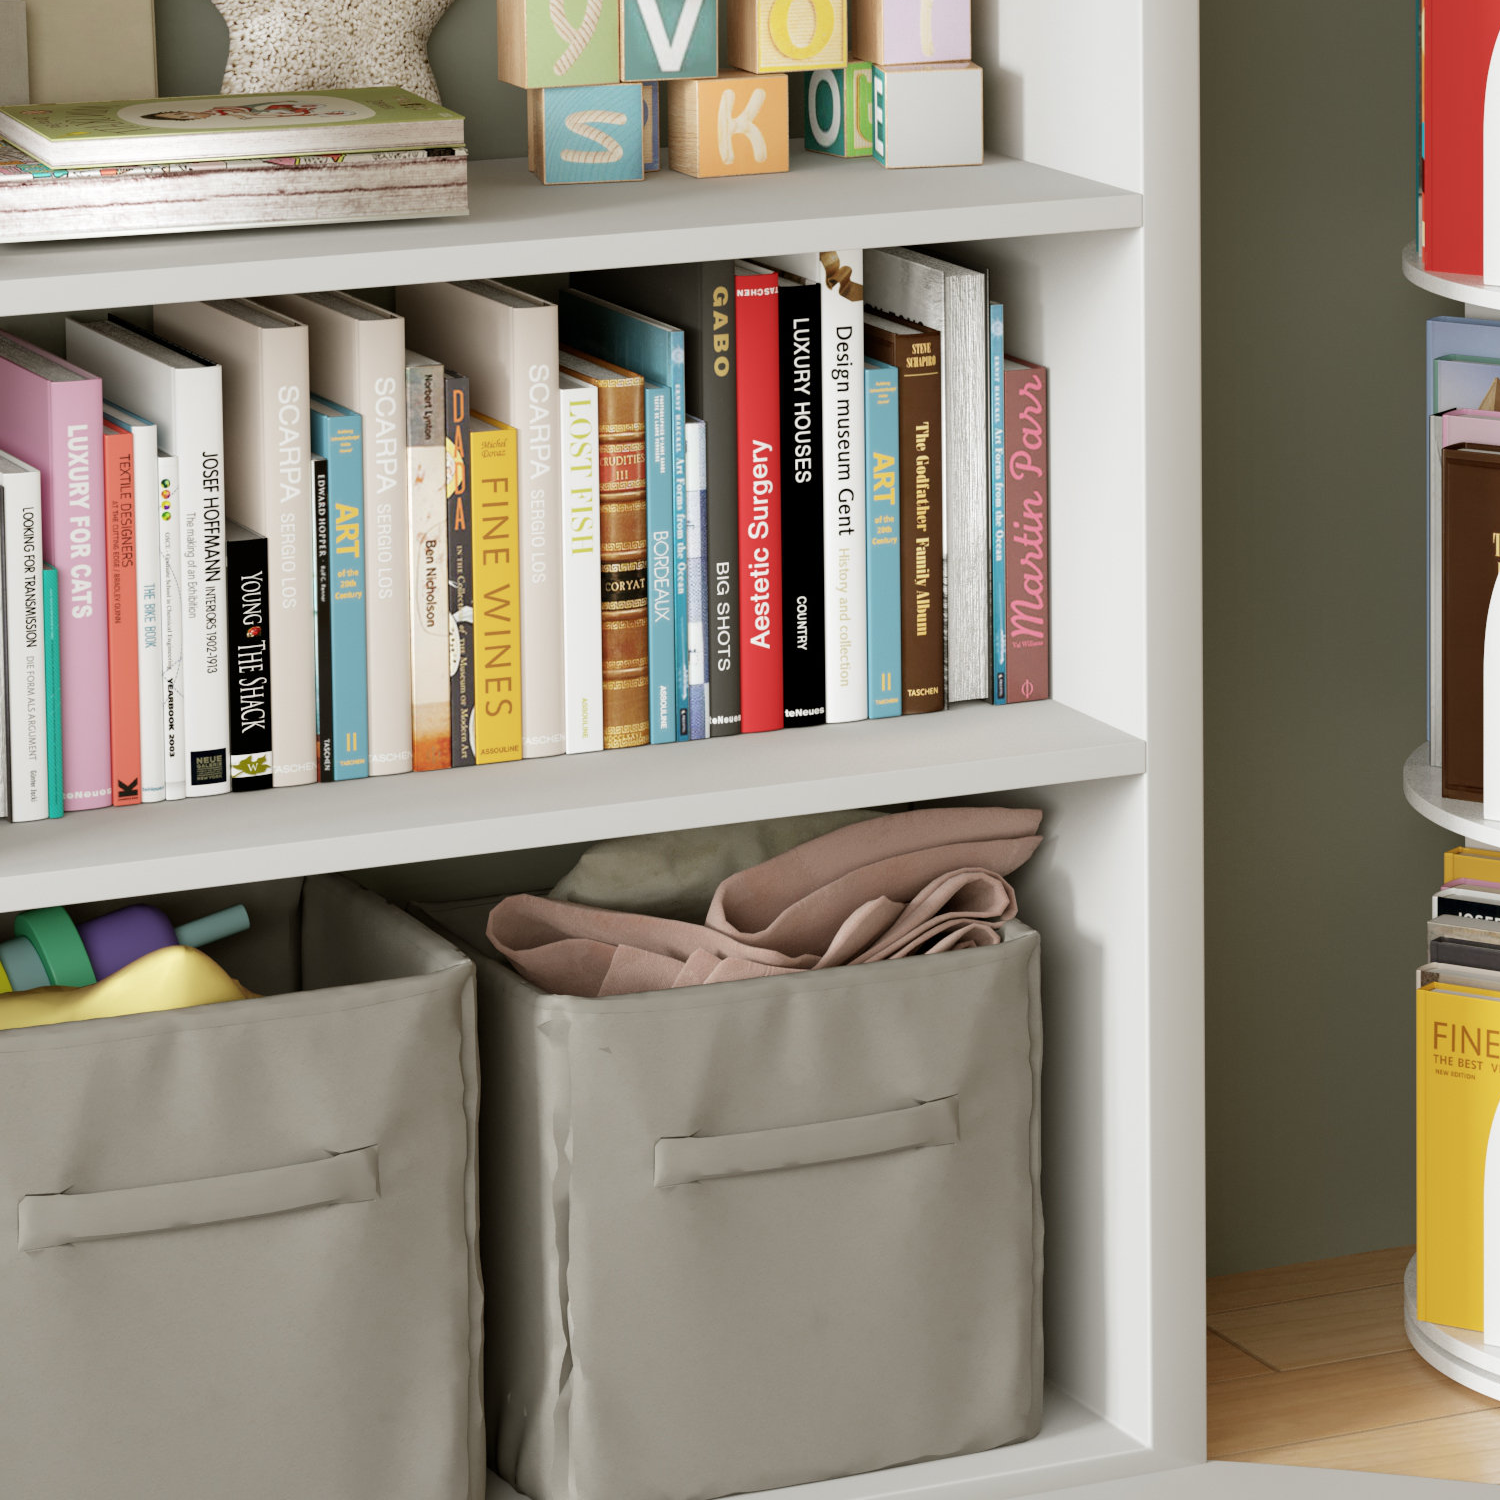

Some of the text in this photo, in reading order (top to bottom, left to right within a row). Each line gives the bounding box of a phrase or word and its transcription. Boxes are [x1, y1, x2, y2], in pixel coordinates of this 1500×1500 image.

[560, 110, 628, 164] S
[716, 88, 768, 166] K
[712, 286, 730, 377] GABO
[906, 354, 936, 368] SCHAPIRO
[912, 342, 932, 354] STEVE
[793, 318, 812, 483] LUXURY HOUSES
[832, 326, 854, 536] Design museum Gent
[120, 454, 134, 568] TEXTILE DESIGNERS
[278, 386, 301, 610] SCARPA SERGIO LOS
[317, 474, 328, 557] EDWARD HOPPER
[375, 377, 398, 600] SCARPA SERGIO LOS
[453, 390, 466, 531] DADA
[529, 364, 550, 584] SCARPA SERGIO LOS
[570, 400, 594, 554] LOST FISH
[873, 452, 896, 505] ART
[1009, 374, 1044, 638] Martin Parr
[68, 424, 92, 618] LUXURY FOR CATS
[203, 452, 220, 674] JOSEF HOFFMANN INTERIORS 1902-1913
[335, 503, 360, 558] ART
[653, 530, 670, 622] BORDEAUX
[748, 440, 772, 650] Aestetic Surgery
[914, 422, 930, 636] The Godfather Family Album
[22, 506, 38, 648] LOOKING FOR TRANSMISSION
[426, 540, 436, 628] Ben Nicholson
[482, 478, 513, 717] FINE WINES
[605, 578, 646, 592] CORYAT
[716, 562, 730, 672] BIG SHOTS
[796, 596, 808, 650] COUNTRY
[836, 548, 852, 687] History and collection
[238, 570, 267, 734] YOUNG THE SHACK
[908, 686, 938, 698] TASCHEN
[480, 745, 519, 756] ASSOULINE
[784, 707, 824, 718] teNeues
[1434, 1022, 1500, 1059] FINE
[1450, 1071, 1476, 1080] EDITION
